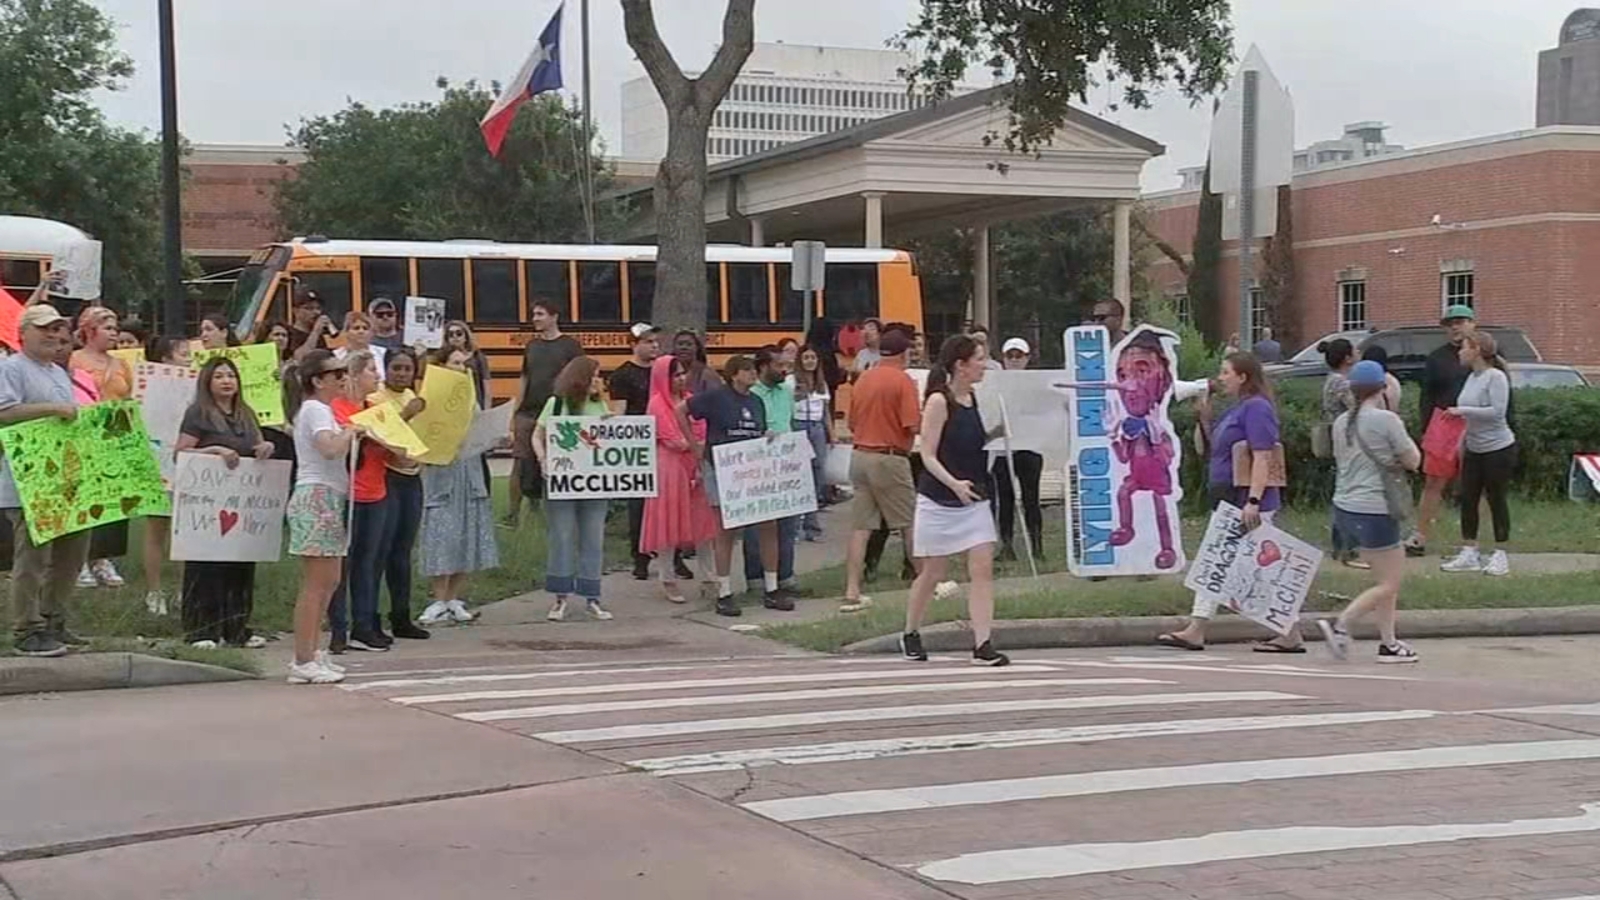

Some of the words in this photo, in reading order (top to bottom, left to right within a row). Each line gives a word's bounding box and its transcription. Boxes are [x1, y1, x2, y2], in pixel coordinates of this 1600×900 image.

[1075, 330, 1108, 437] MIKE
[589, 425, 652, 440] DRAGONS
[593, 446, 650, 467] LOVE
[549, 473, 655, 493] MCCLISH!
[1078, 447, 1116, 566] LYING
[1266, 553, 1315, 629] McClish!
